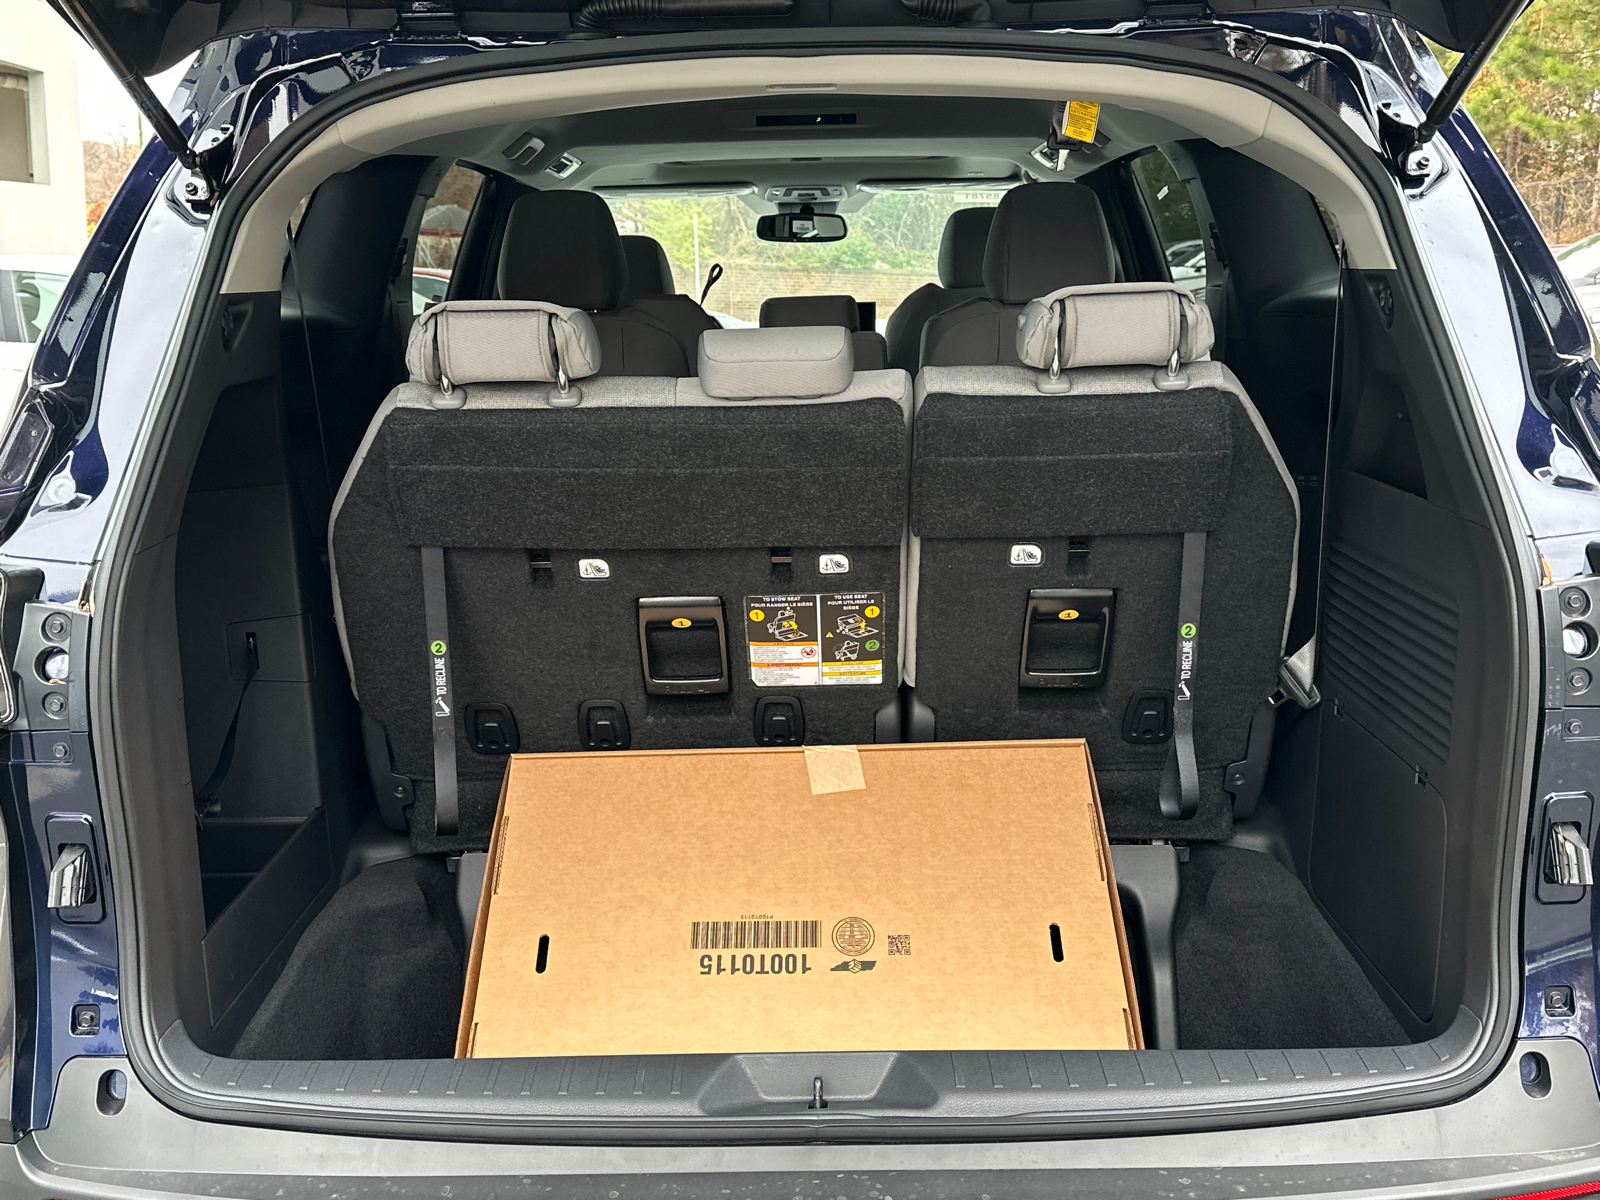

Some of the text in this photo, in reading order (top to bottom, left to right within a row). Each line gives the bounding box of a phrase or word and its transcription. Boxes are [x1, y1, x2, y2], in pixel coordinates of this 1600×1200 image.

[434, 657, 448, 696] TO RECLINE
[1180, 640, 1193, 680] TO RECLINE
[699, 953, 812, 975] 100T0115
